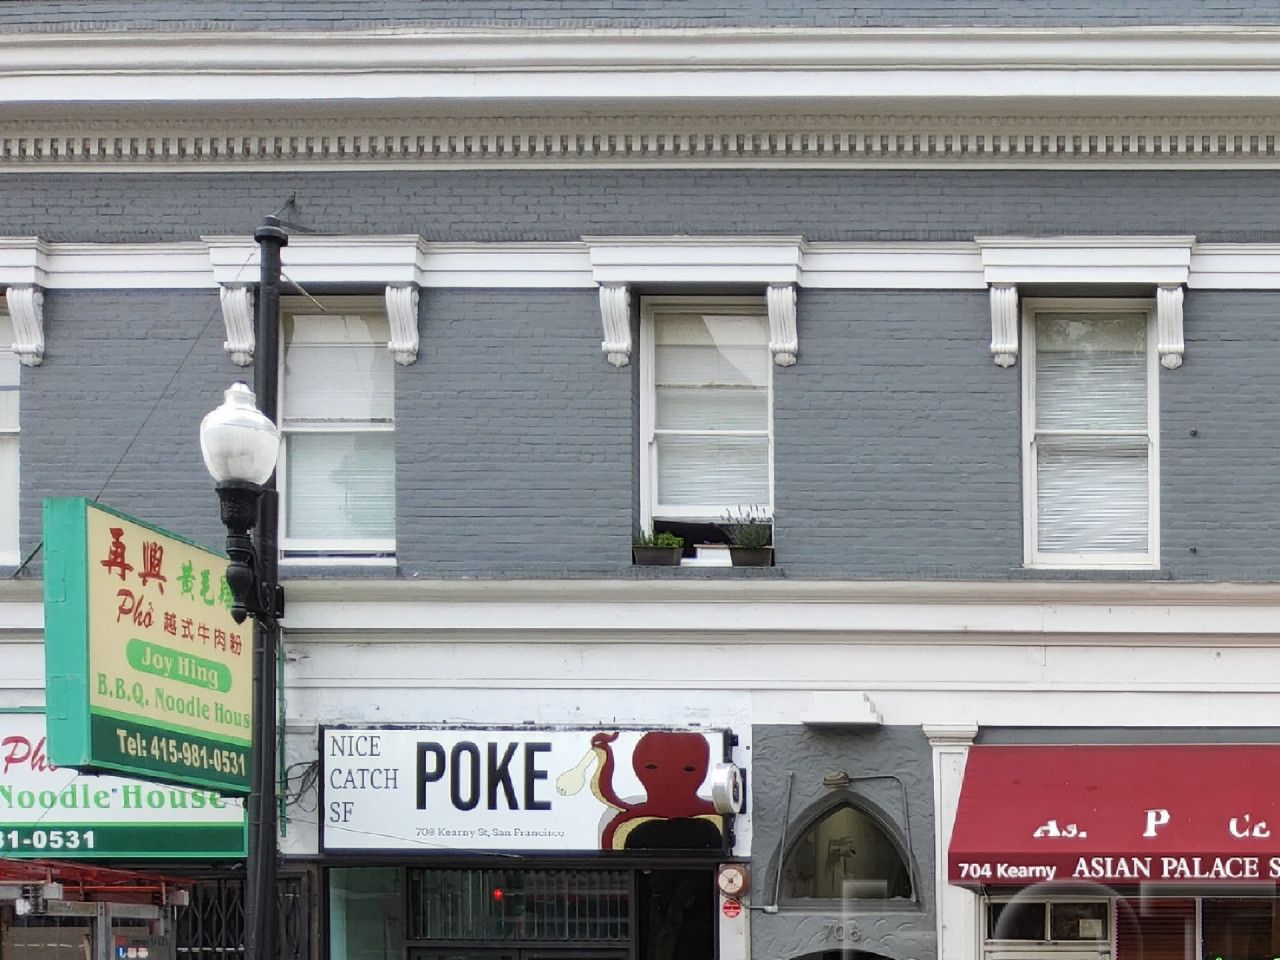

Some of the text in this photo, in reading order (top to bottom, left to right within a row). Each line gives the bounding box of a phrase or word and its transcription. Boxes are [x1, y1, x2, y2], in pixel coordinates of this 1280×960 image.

[164, 611, 242, 656] 越式牛肉粉
[141, 647, 218, 689] Joy Hing
[97, 672, 251, 728] B.B.Q. Noodle Hous
[116, 728, 246, 776] Tel: 415-981-0531
[330, 735, 381, 757] NICE
[330, 768, 399, 790] CATCH
[416, 741, 552, 811] POKE
[330, 801, 354, 823] SF
[0, 830, 94, 849] 1-0531
[416, 828, 434, 837] 708
[438, 828, 475, 838] Kearny
[493, 828, 511, 837] San
[959, 863, 992, 878] 704
[997, 863, 1057, 880] Kearny
[1072, 857, 1152, 878] ASIAN
[1161, 857, 1259, 878] PALACE
